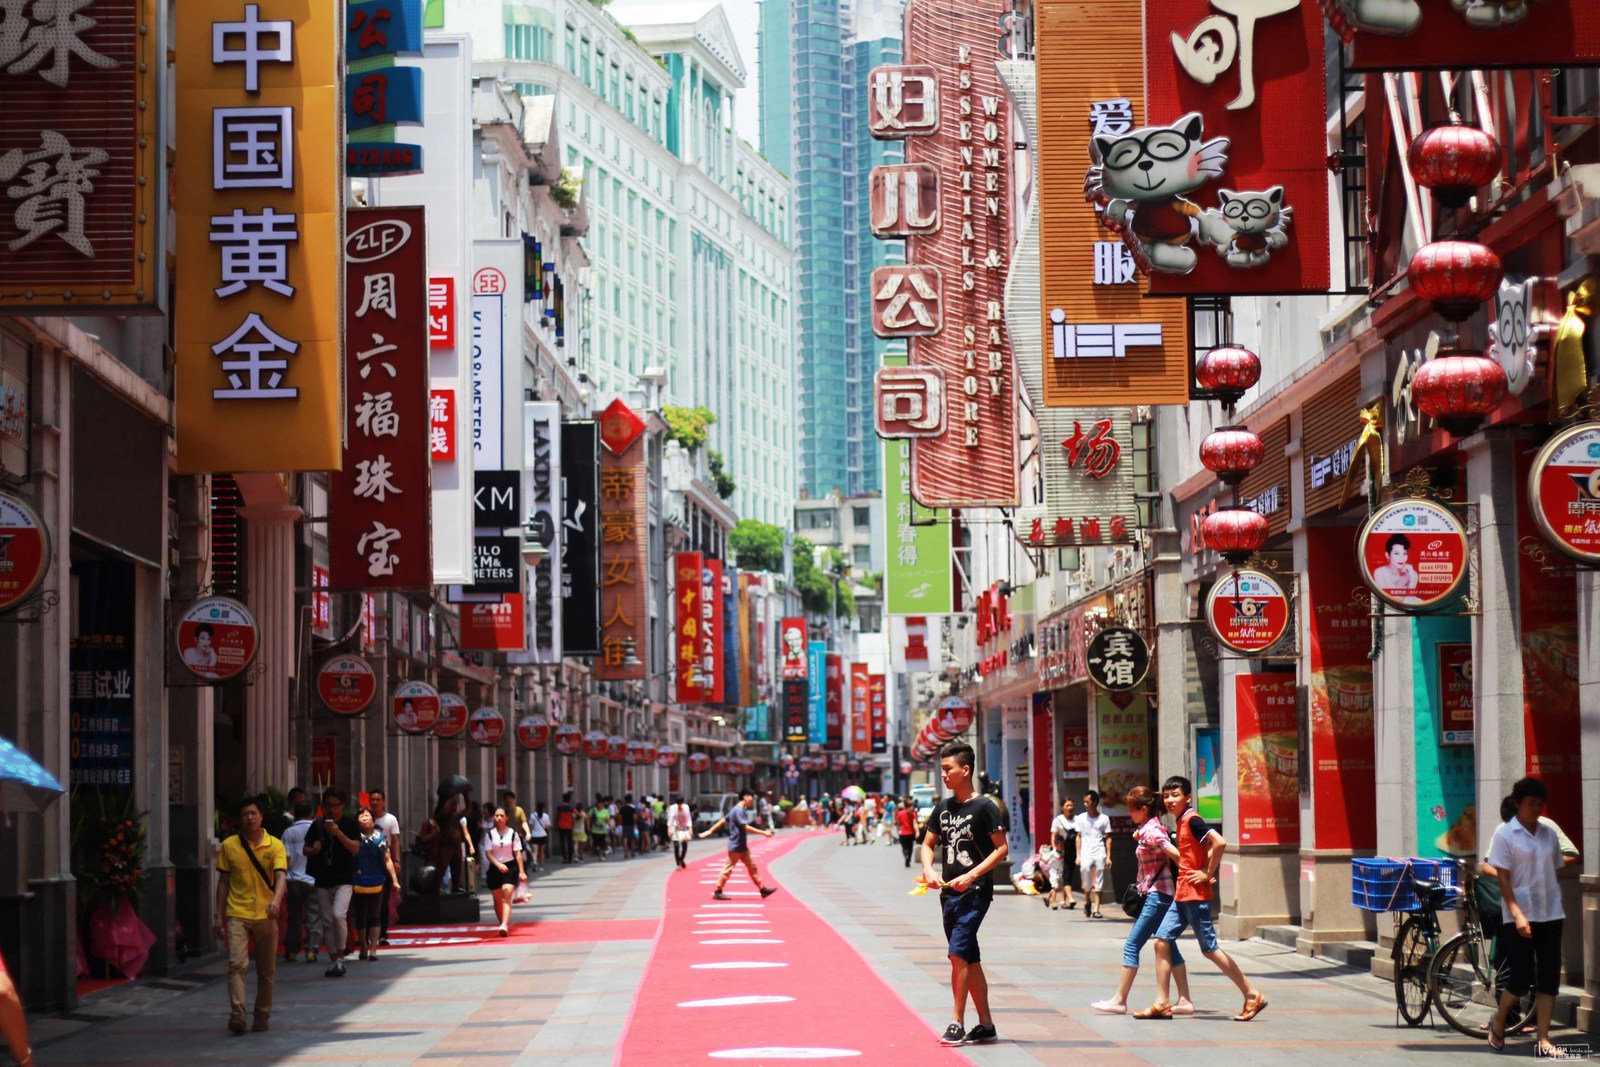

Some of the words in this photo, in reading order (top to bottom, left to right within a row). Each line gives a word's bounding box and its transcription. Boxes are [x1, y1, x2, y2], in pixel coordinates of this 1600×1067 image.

[350, 8, 392, 122] 公司
[209, 3, 300, 400] 中国黄金
[957, 45, 975, 292] ESSENTIALS
[981, 97, 1000, 217] WOMEN
[1090, 97, 1137, 285] 爱服
[354, 227, 396, 253] ZLF
[872, 71, 941, 430] 妇儿公司
[353, 271, 403, 578] 周六福珠宝
[963, 325, 980, 448] STORE
[783, 668, 806, 678] KFC
[1102, 631, 1134, 686] 宾馆
